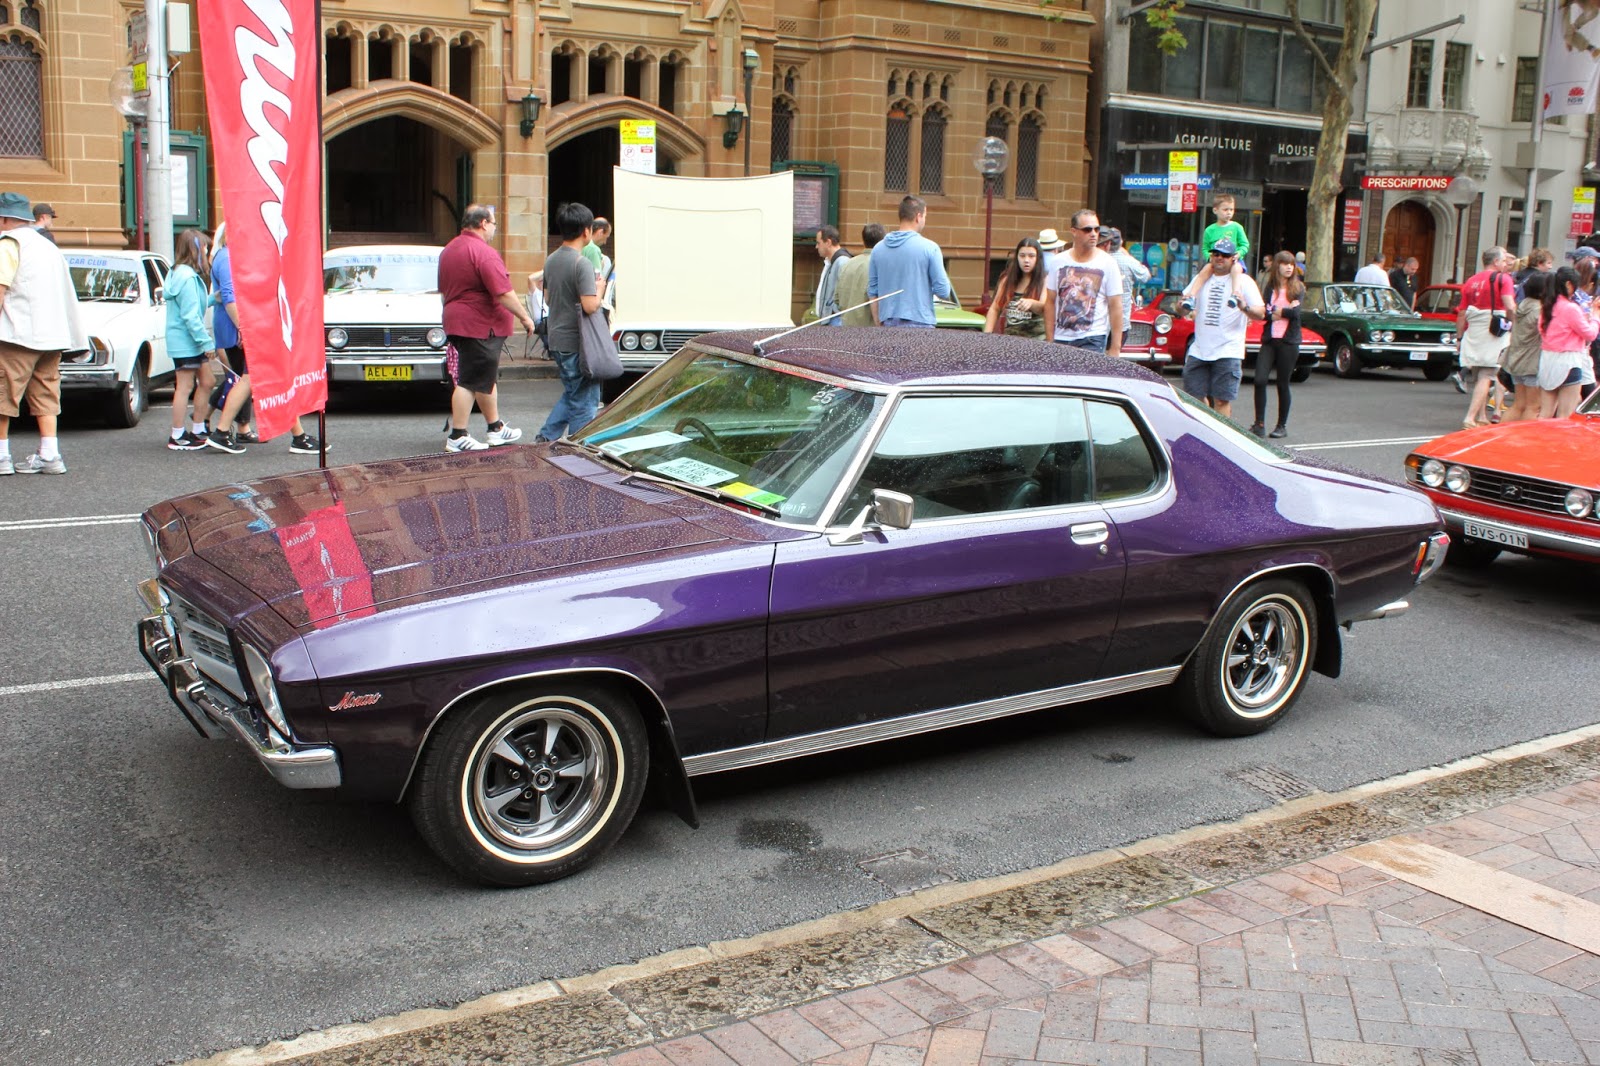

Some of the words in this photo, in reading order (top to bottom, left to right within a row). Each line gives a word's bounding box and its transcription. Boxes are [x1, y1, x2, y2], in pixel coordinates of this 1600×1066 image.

[1174, 133, 1251, 151] AGRICULTURE
[1278, 143, 1315, 157] HOUSE
[1124, 177, 1162, 186] MACQUARIE
[1367, 178, 1447, 189] PRESCRIPTIONS
[87, 259, 108, 267] CLUB
[367, 366, 387, 377] AEL
[392, 367, 408, 377] 411
